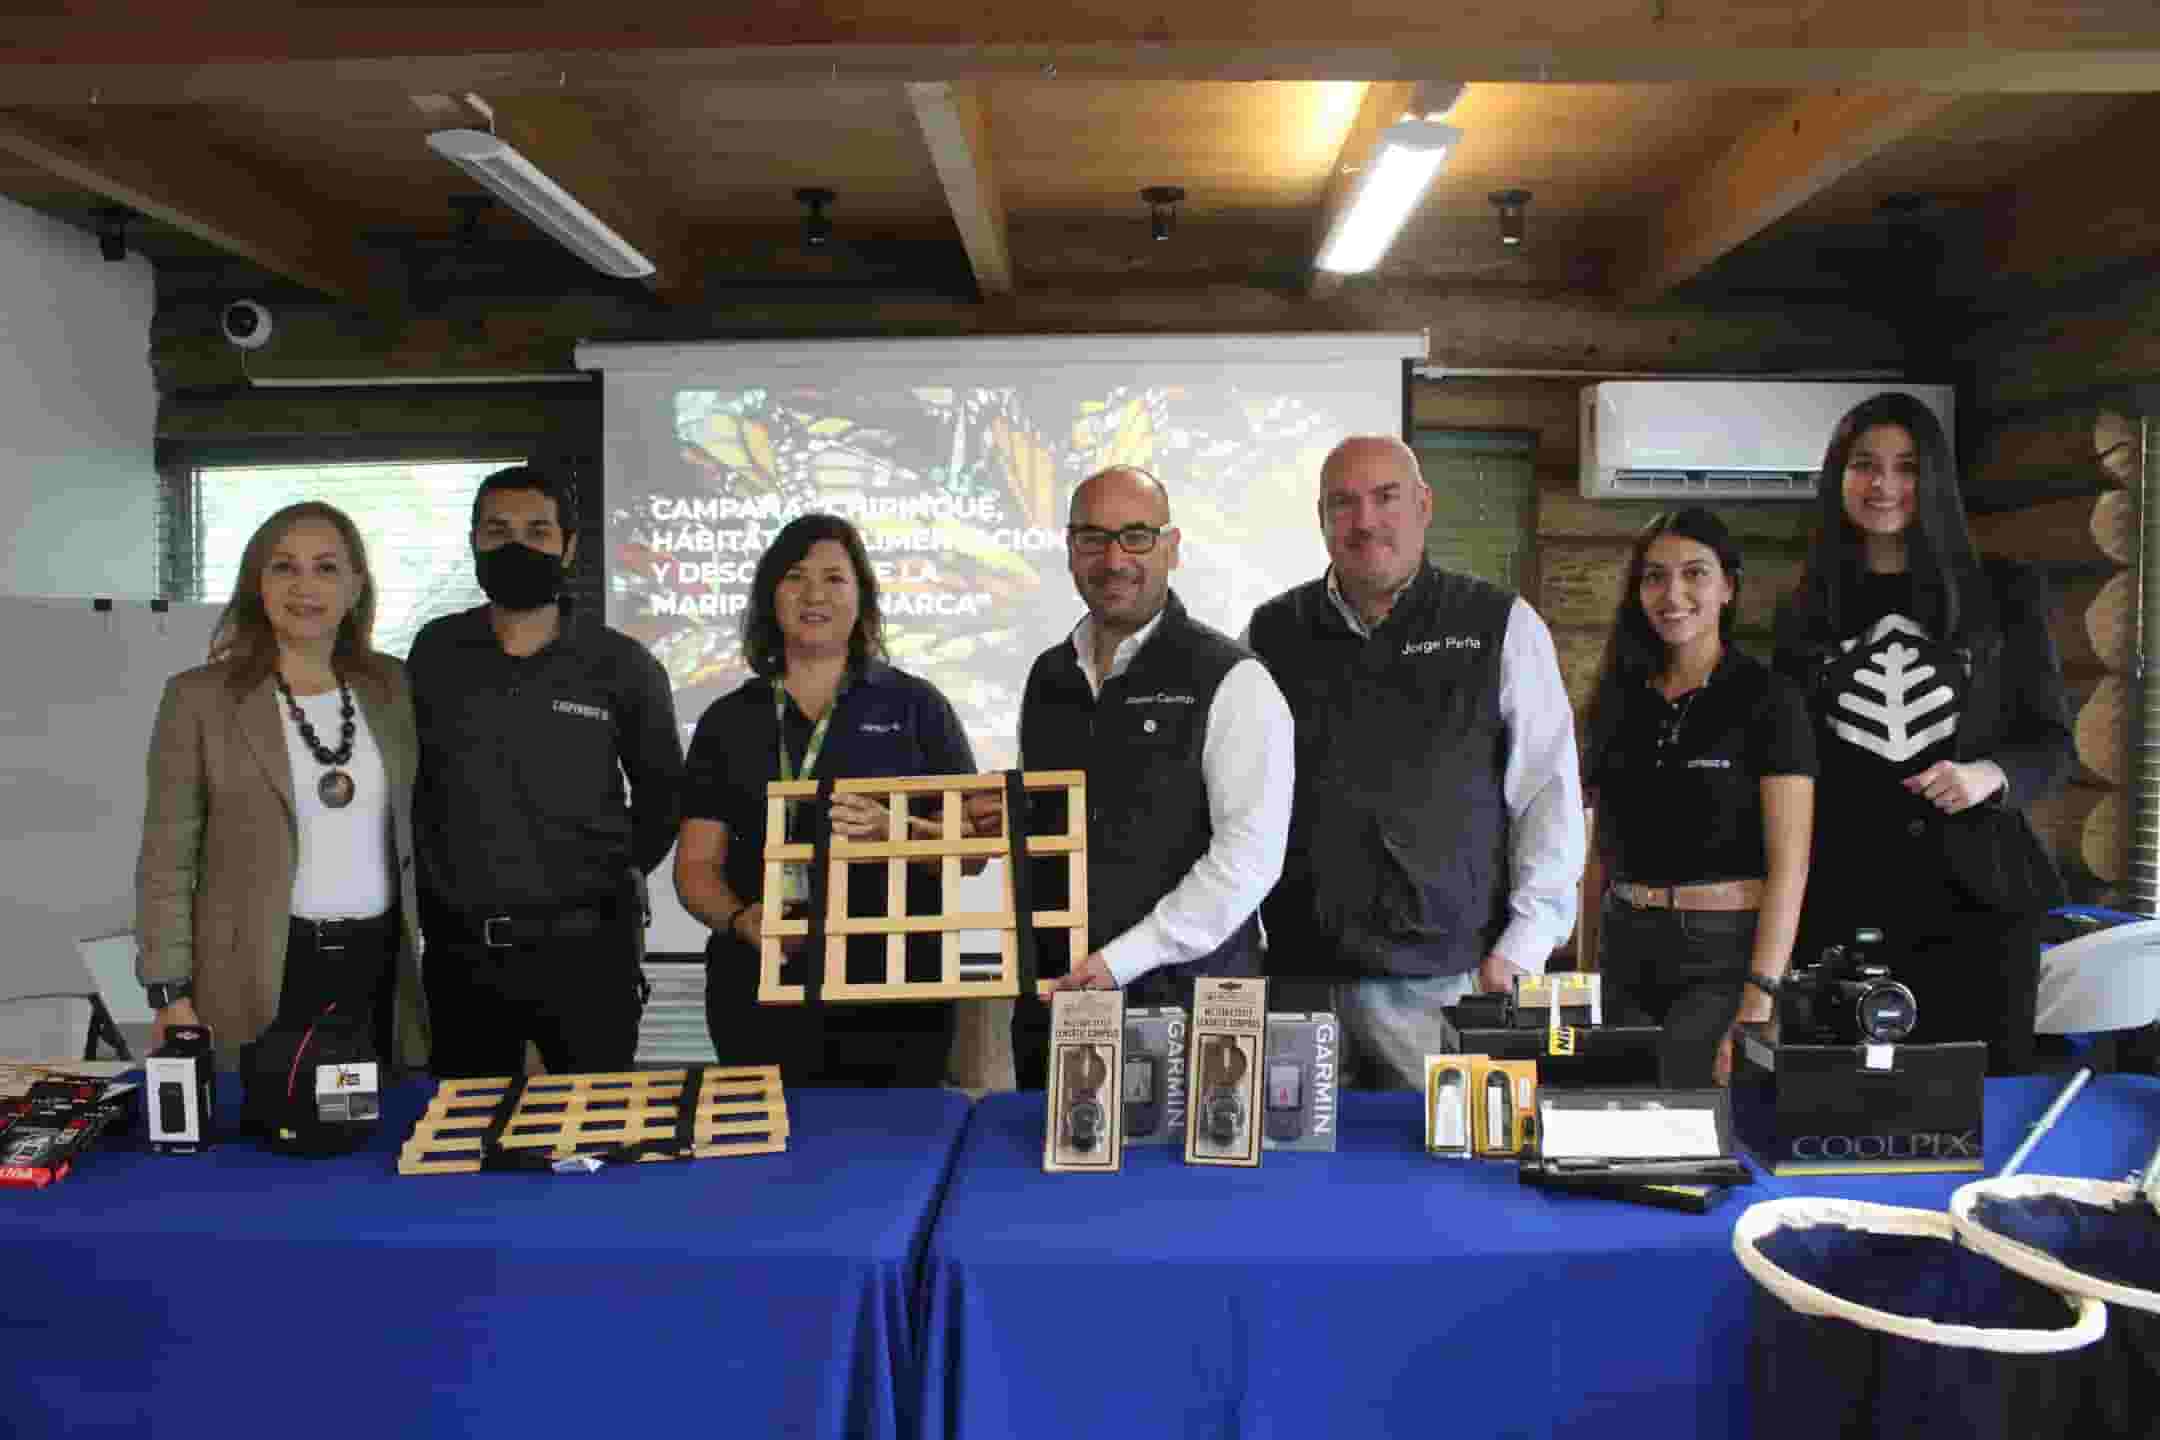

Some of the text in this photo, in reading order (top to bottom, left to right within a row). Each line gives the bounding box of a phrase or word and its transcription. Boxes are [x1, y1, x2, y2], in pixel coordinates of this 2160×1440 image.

[651, 562, 671, 584] Y
[1168, 1022, 1186, 1129] GARMIN
[1313, 1023, 1335, 1136] GARMIN
[1791, 1130, 1976, 1160] COOLPIX
